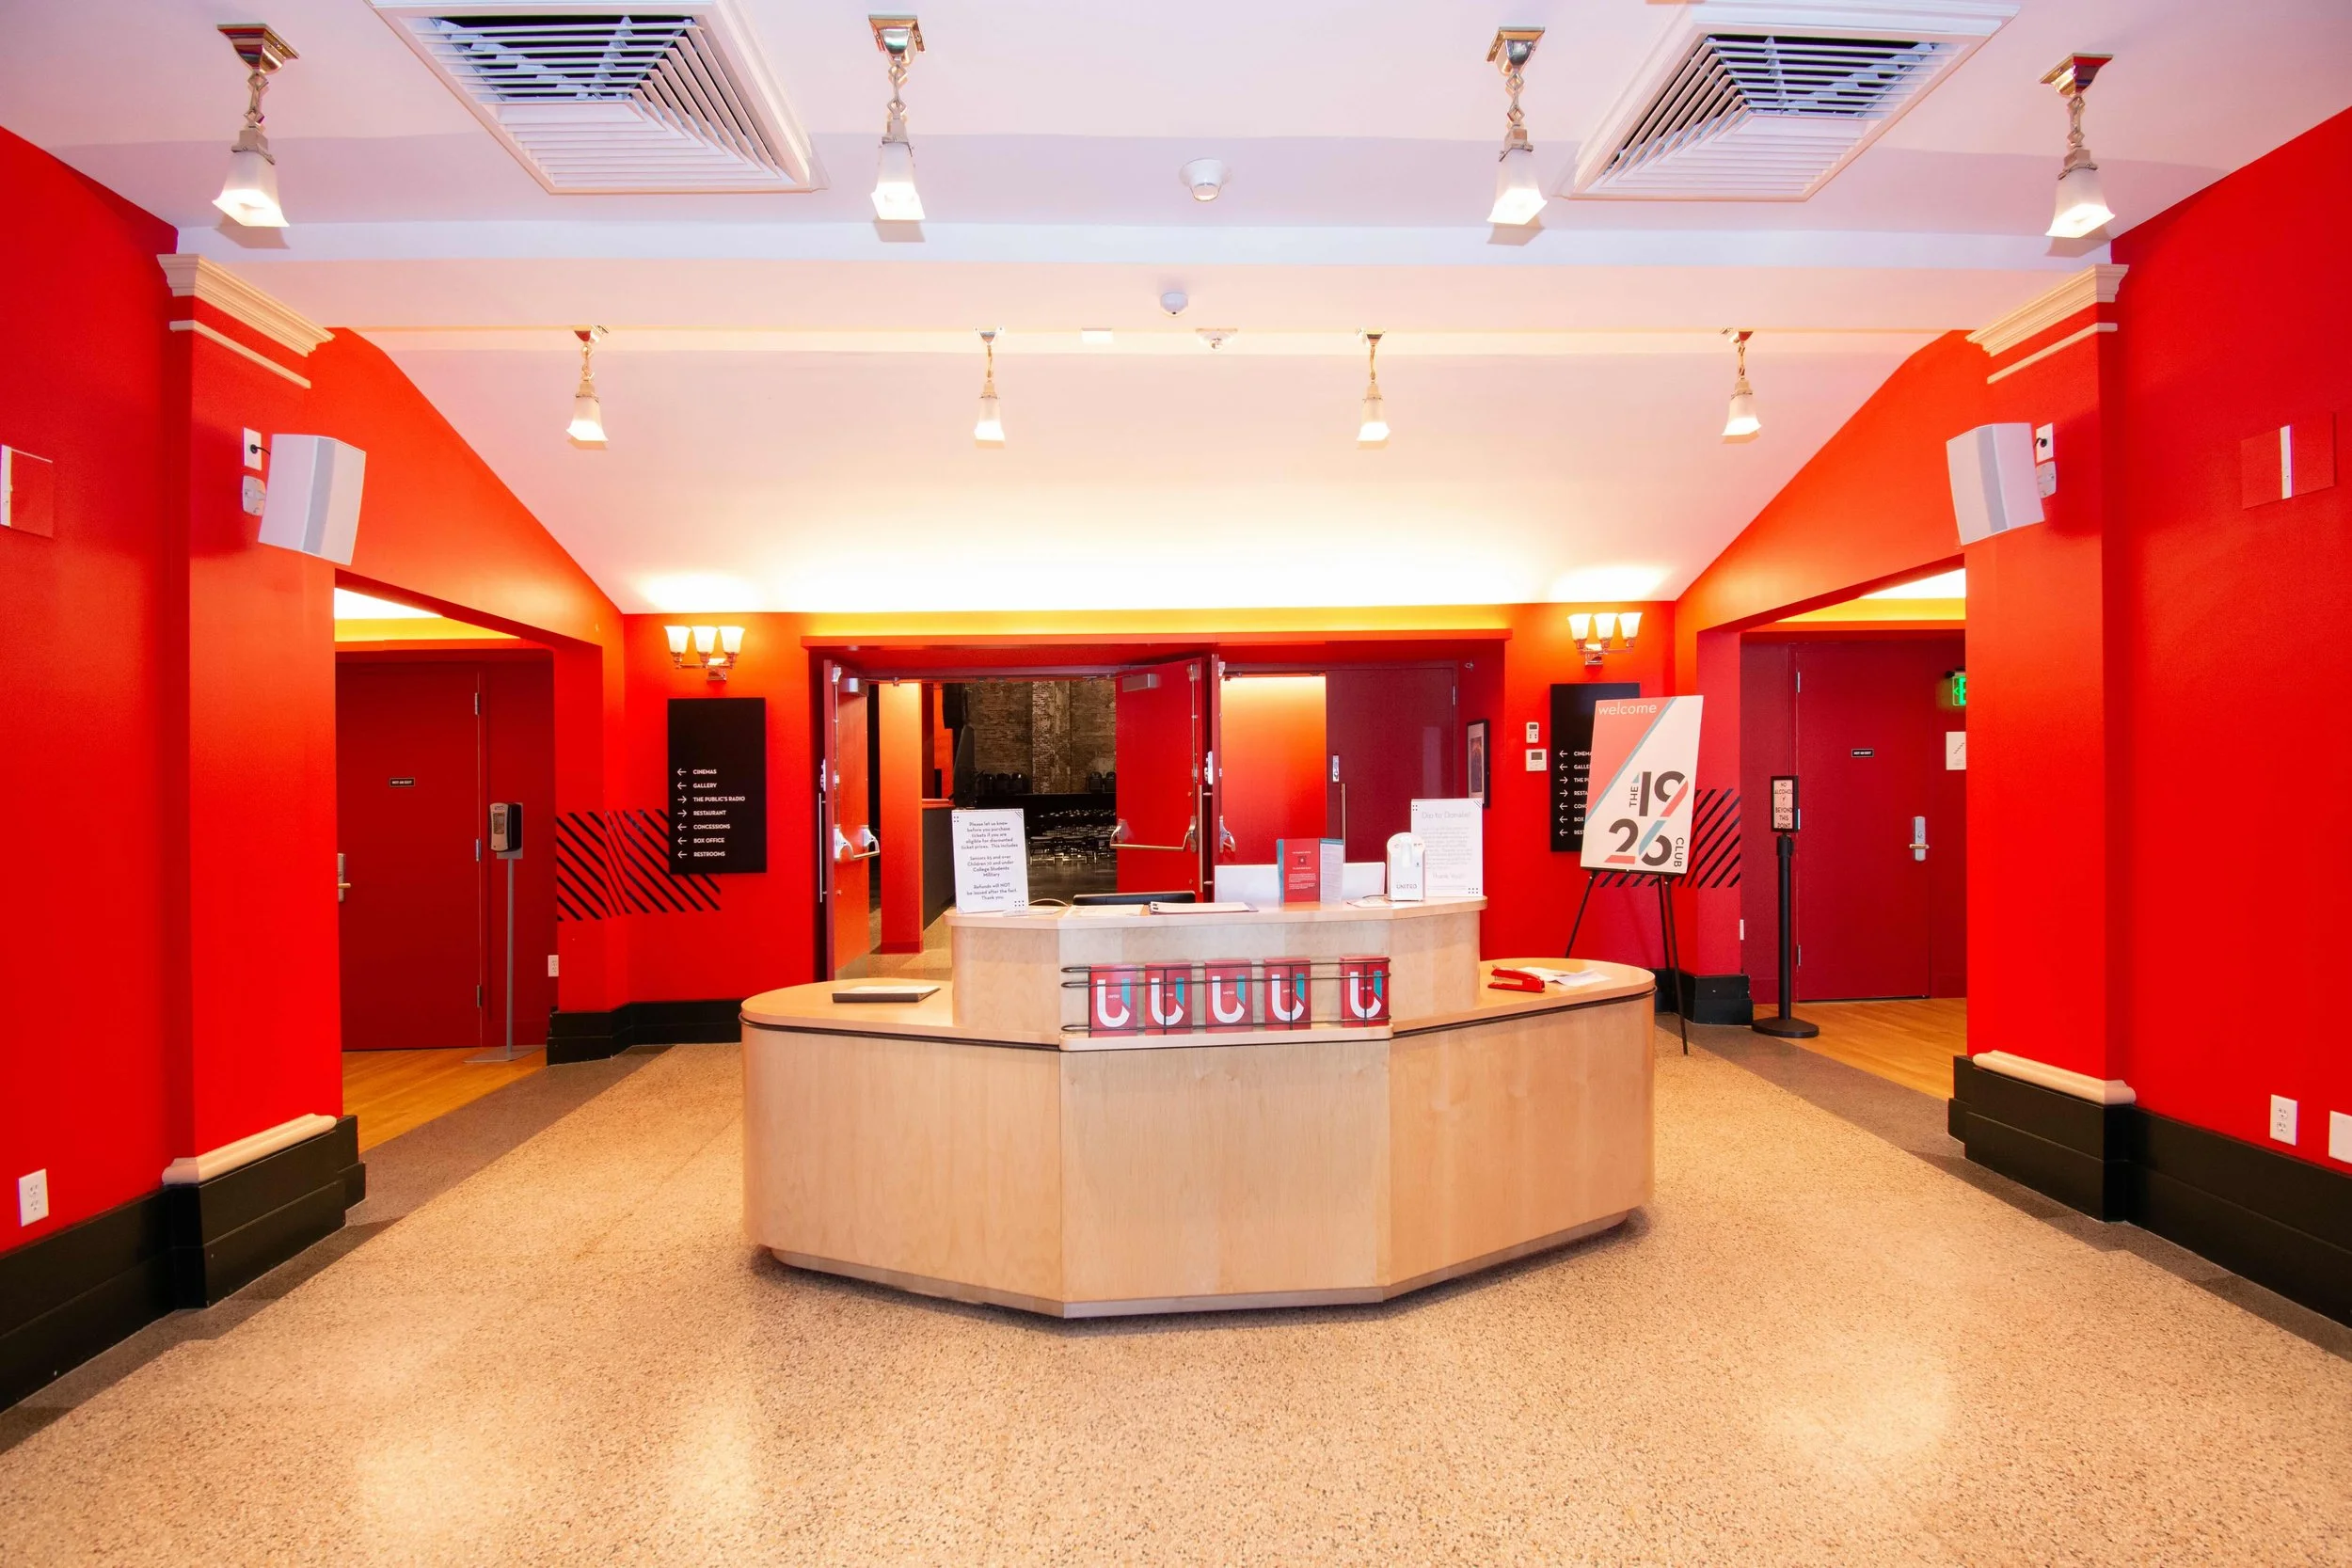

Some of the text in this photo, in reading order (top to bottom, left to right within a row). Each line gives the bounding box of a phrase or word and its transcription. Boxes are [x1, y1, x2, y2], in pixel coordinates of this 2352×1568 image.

[1597, 702, 1657, 716] welcome
[1629, 785, 1639, 807] THE
[1639, 770, 1689, 817] 19
[1604, 817, 1673, 866] 26
[1674, 837, 1684, 867] CLUB
